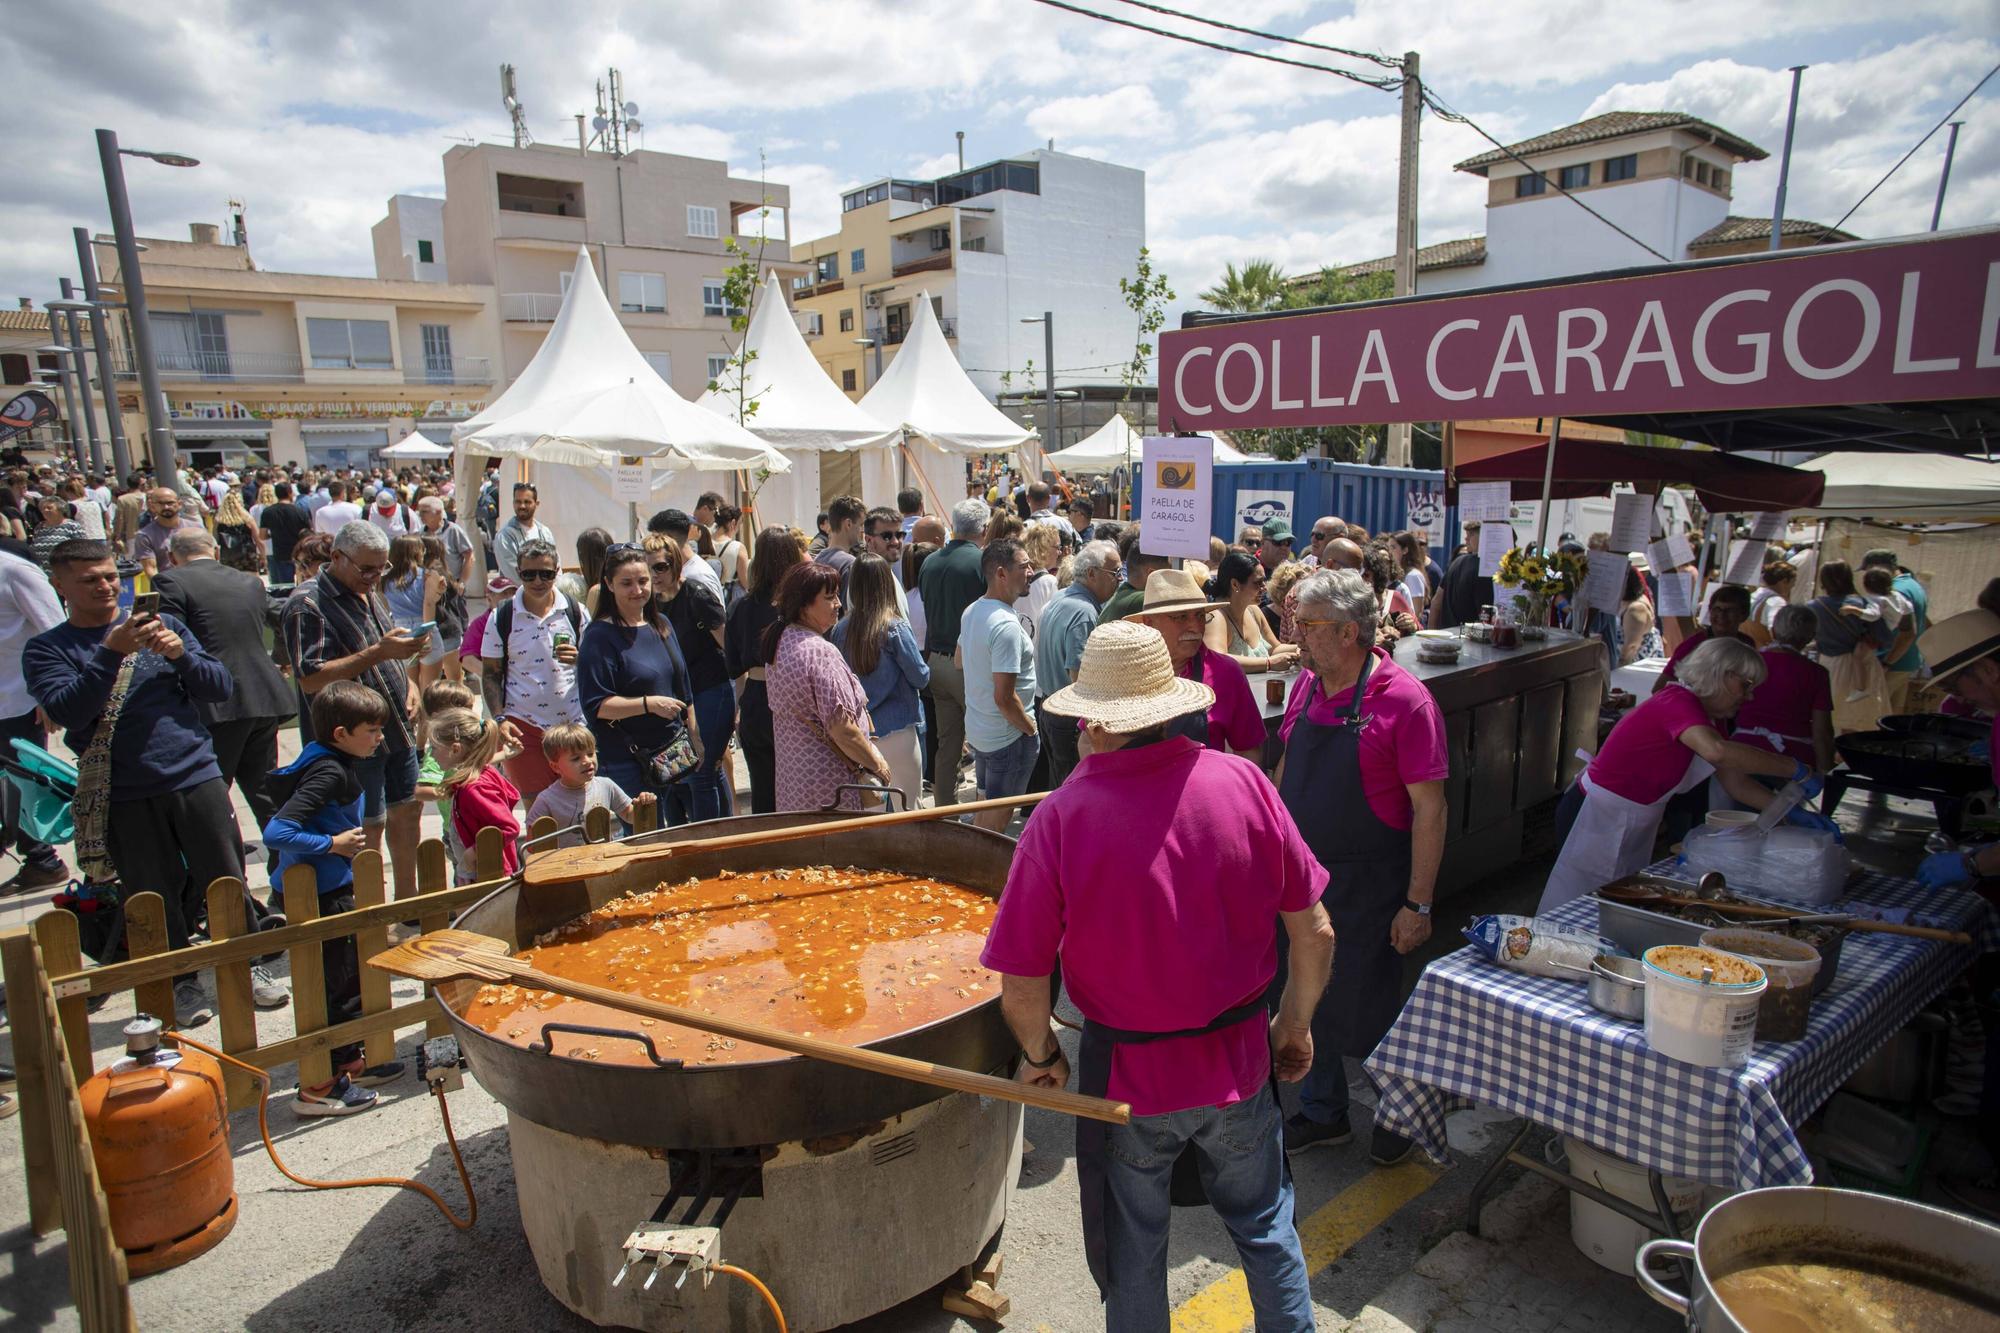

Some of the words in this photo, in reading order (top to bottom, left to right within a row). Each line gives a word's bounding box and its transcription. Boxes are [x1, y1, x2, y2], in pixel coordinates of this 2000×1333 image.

[1174, 328, 1400, 416] COLLA
[261, 402, 276, 412] LA
[318, 402, 353, 413] FRUTA
[355, 402, 362, 413] Y
[366, 402, 414, 413] VERDURA
[1151, 497, 1181, 508] PAELLA
[1183, 498, 1195, 509] DE
[1151, 511, 1195, 523] CARAGOLS
